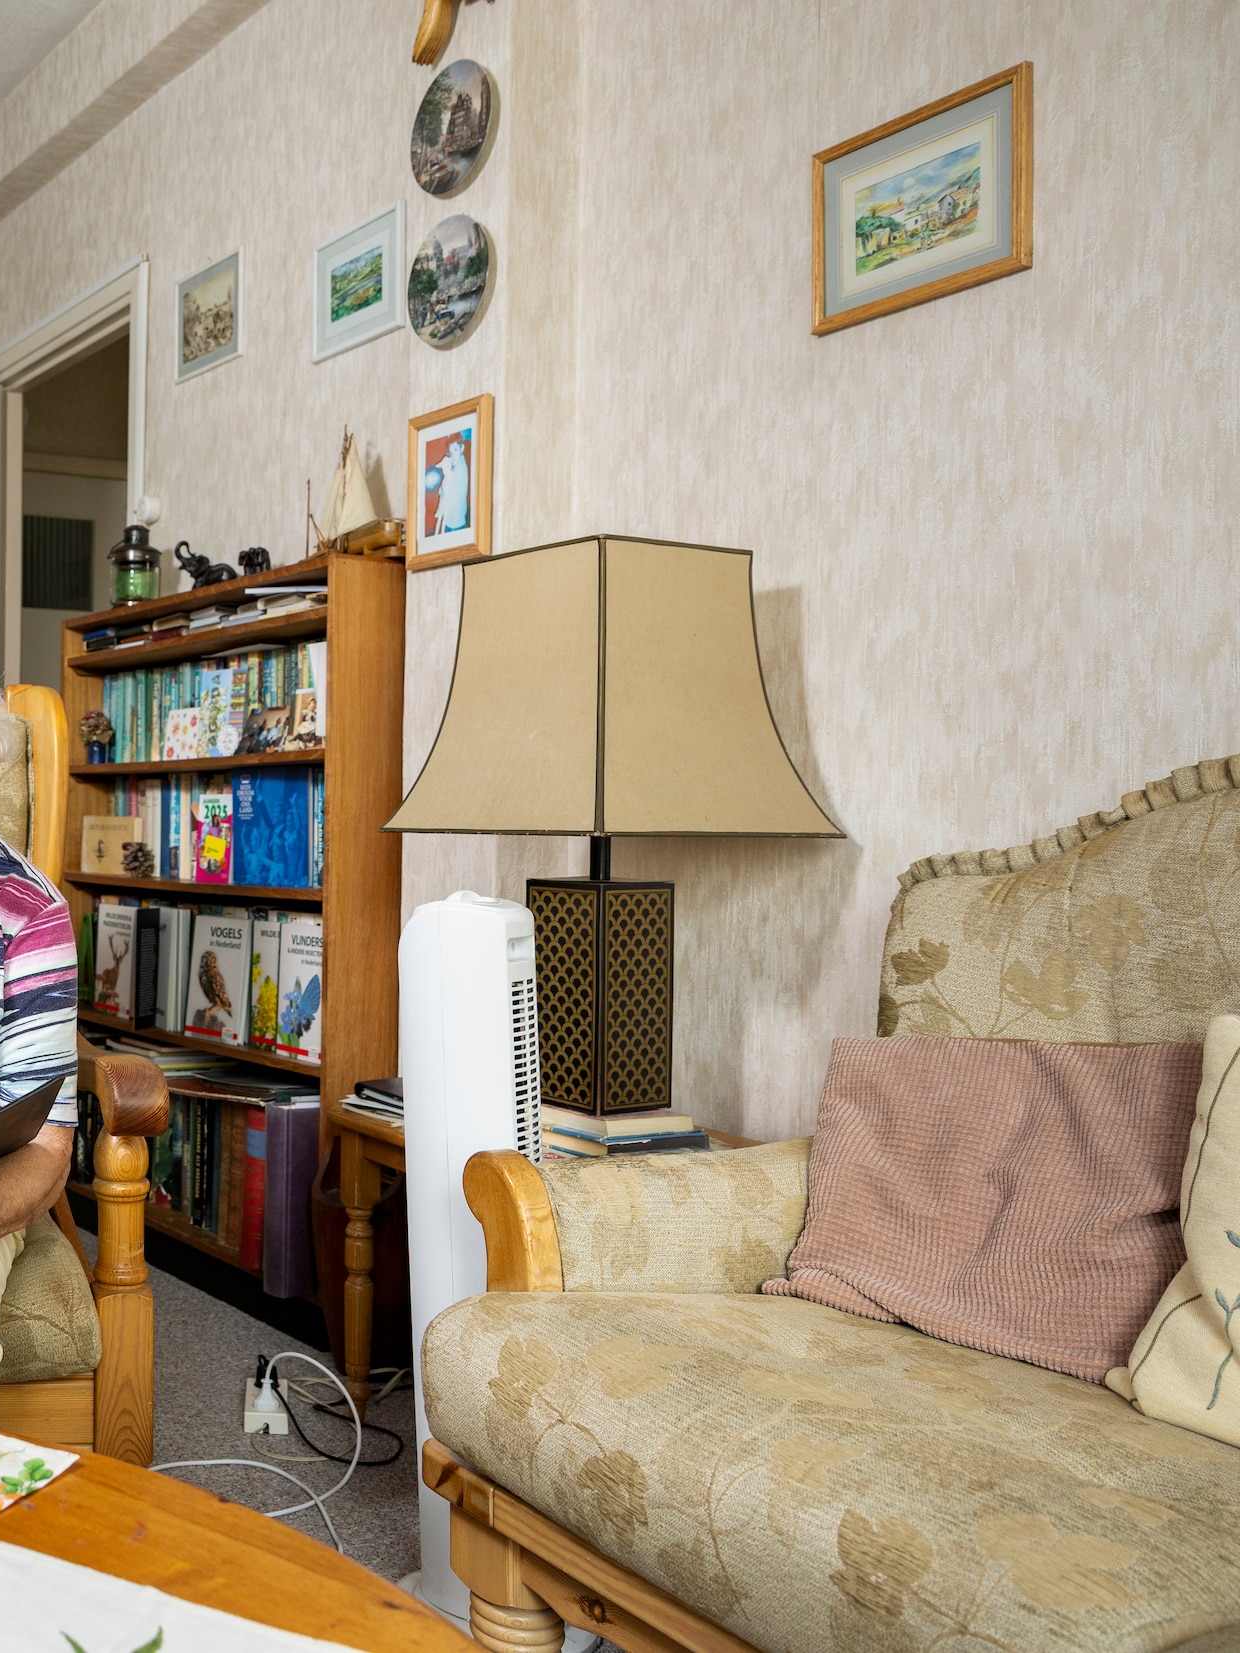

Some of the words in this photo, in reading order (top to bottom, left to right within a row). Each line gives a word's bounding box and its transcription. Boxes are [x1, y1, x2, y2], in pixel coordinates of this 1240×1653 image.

[204, 805, 228, 819] 2025
[210, 925, 242, 940] VOGELS
[260, 930, 276, 938] WILDE
[215, 940, 241, 949] Nederland
[291, 934, 323, 947] VLINDERS
